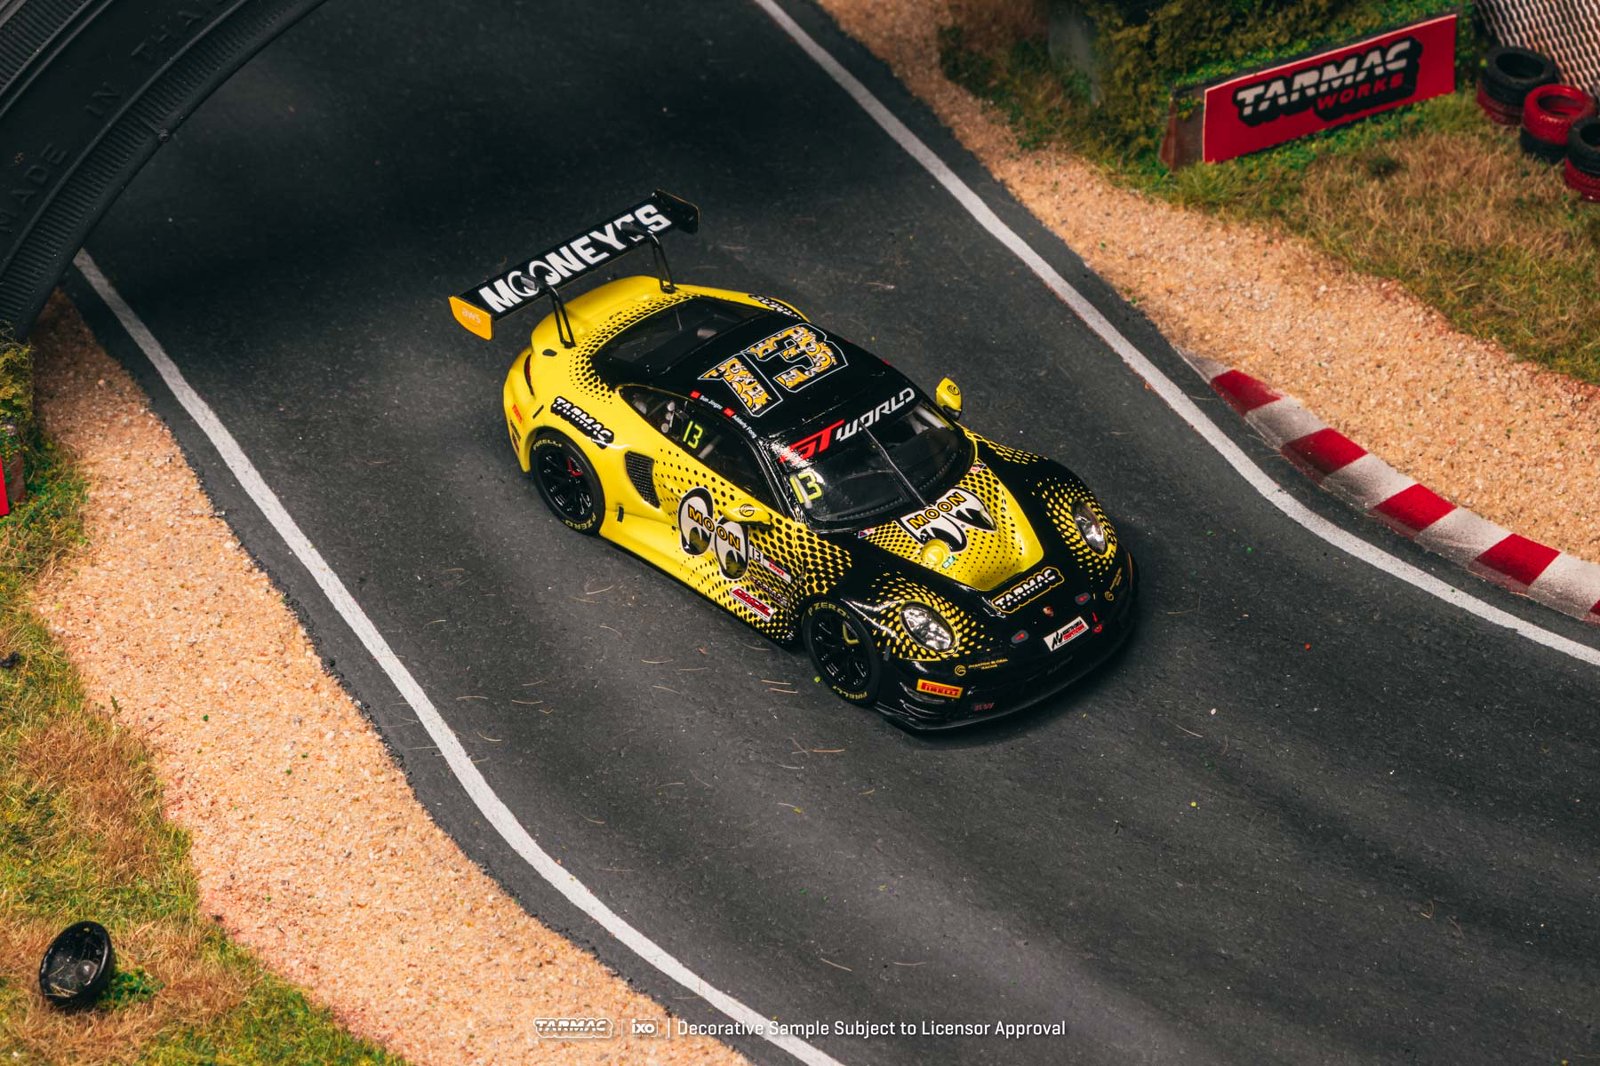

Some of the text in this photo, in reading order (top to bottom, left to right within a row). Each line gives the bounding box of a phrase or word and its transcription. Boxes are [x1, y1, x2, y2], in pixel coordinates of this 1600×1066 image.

[130, 0, 227, 60] THA
[1236, 40, 1411, 117] TARMAC
[1317, 74, 1405, 110] WORKS
[697, 322, 849, 418] 13
[553, 396, 613, 444] TARMAC
[682, 420, 705, 450] 13
[835, 386, 917, 443] WORLD
[788, 469, 824, 505] 13
[687, 503, 741, 552] MOON
[906, 491, 968, 531] MOON
[993, 568, 1056, 611] TARMAC
[921, 682, 960, 697] PIRELLI
